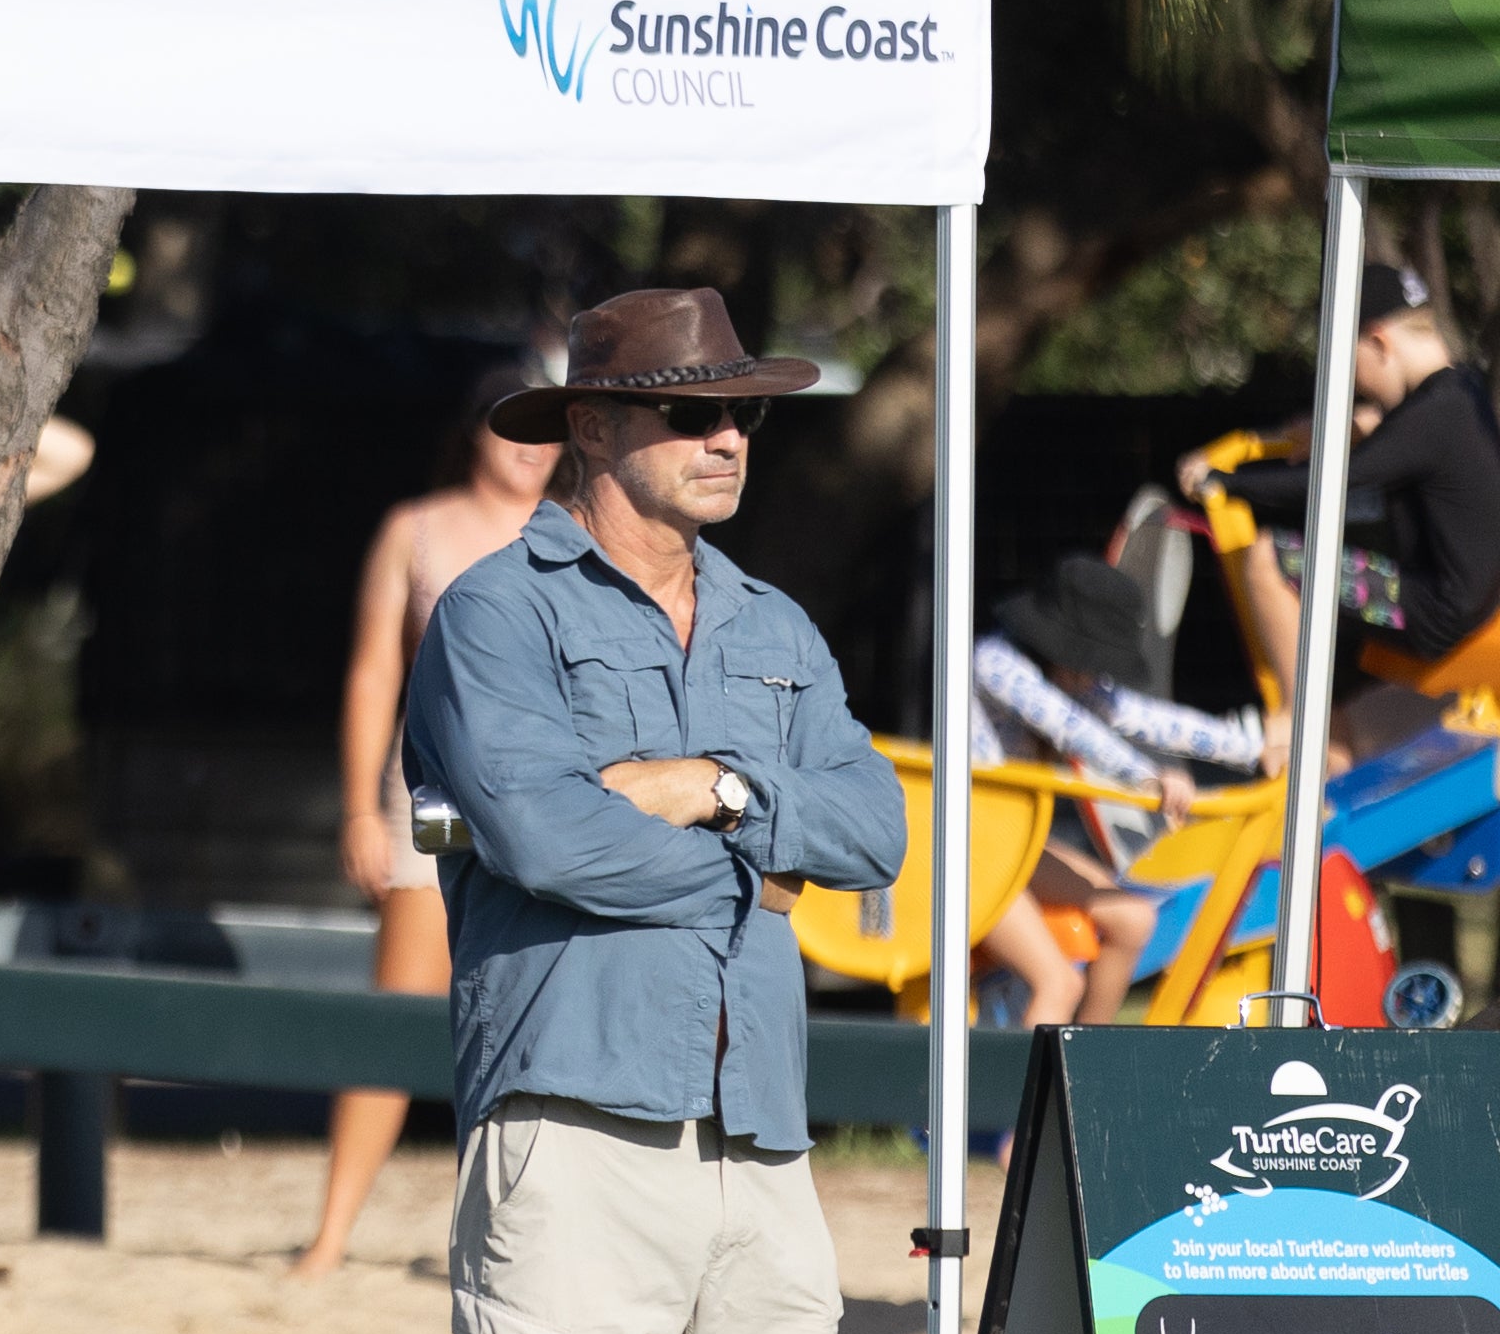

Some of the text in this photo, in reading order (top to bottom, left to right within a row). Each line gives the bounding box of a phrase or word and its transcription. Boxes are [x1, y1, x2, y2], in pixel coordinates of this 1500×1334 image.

[611, 67, 755, 108] COUNCIL
[1231, 1125, 1377, 1155] TurtleCare
[1251, 1157, 1362, 1172] SUNSHINE COAST
[1172, 1238, 1456, 1262] Join your local TurtleCare volunteers
[1163, 1261, 1469, 1285] to learn more about endangered Turtles
